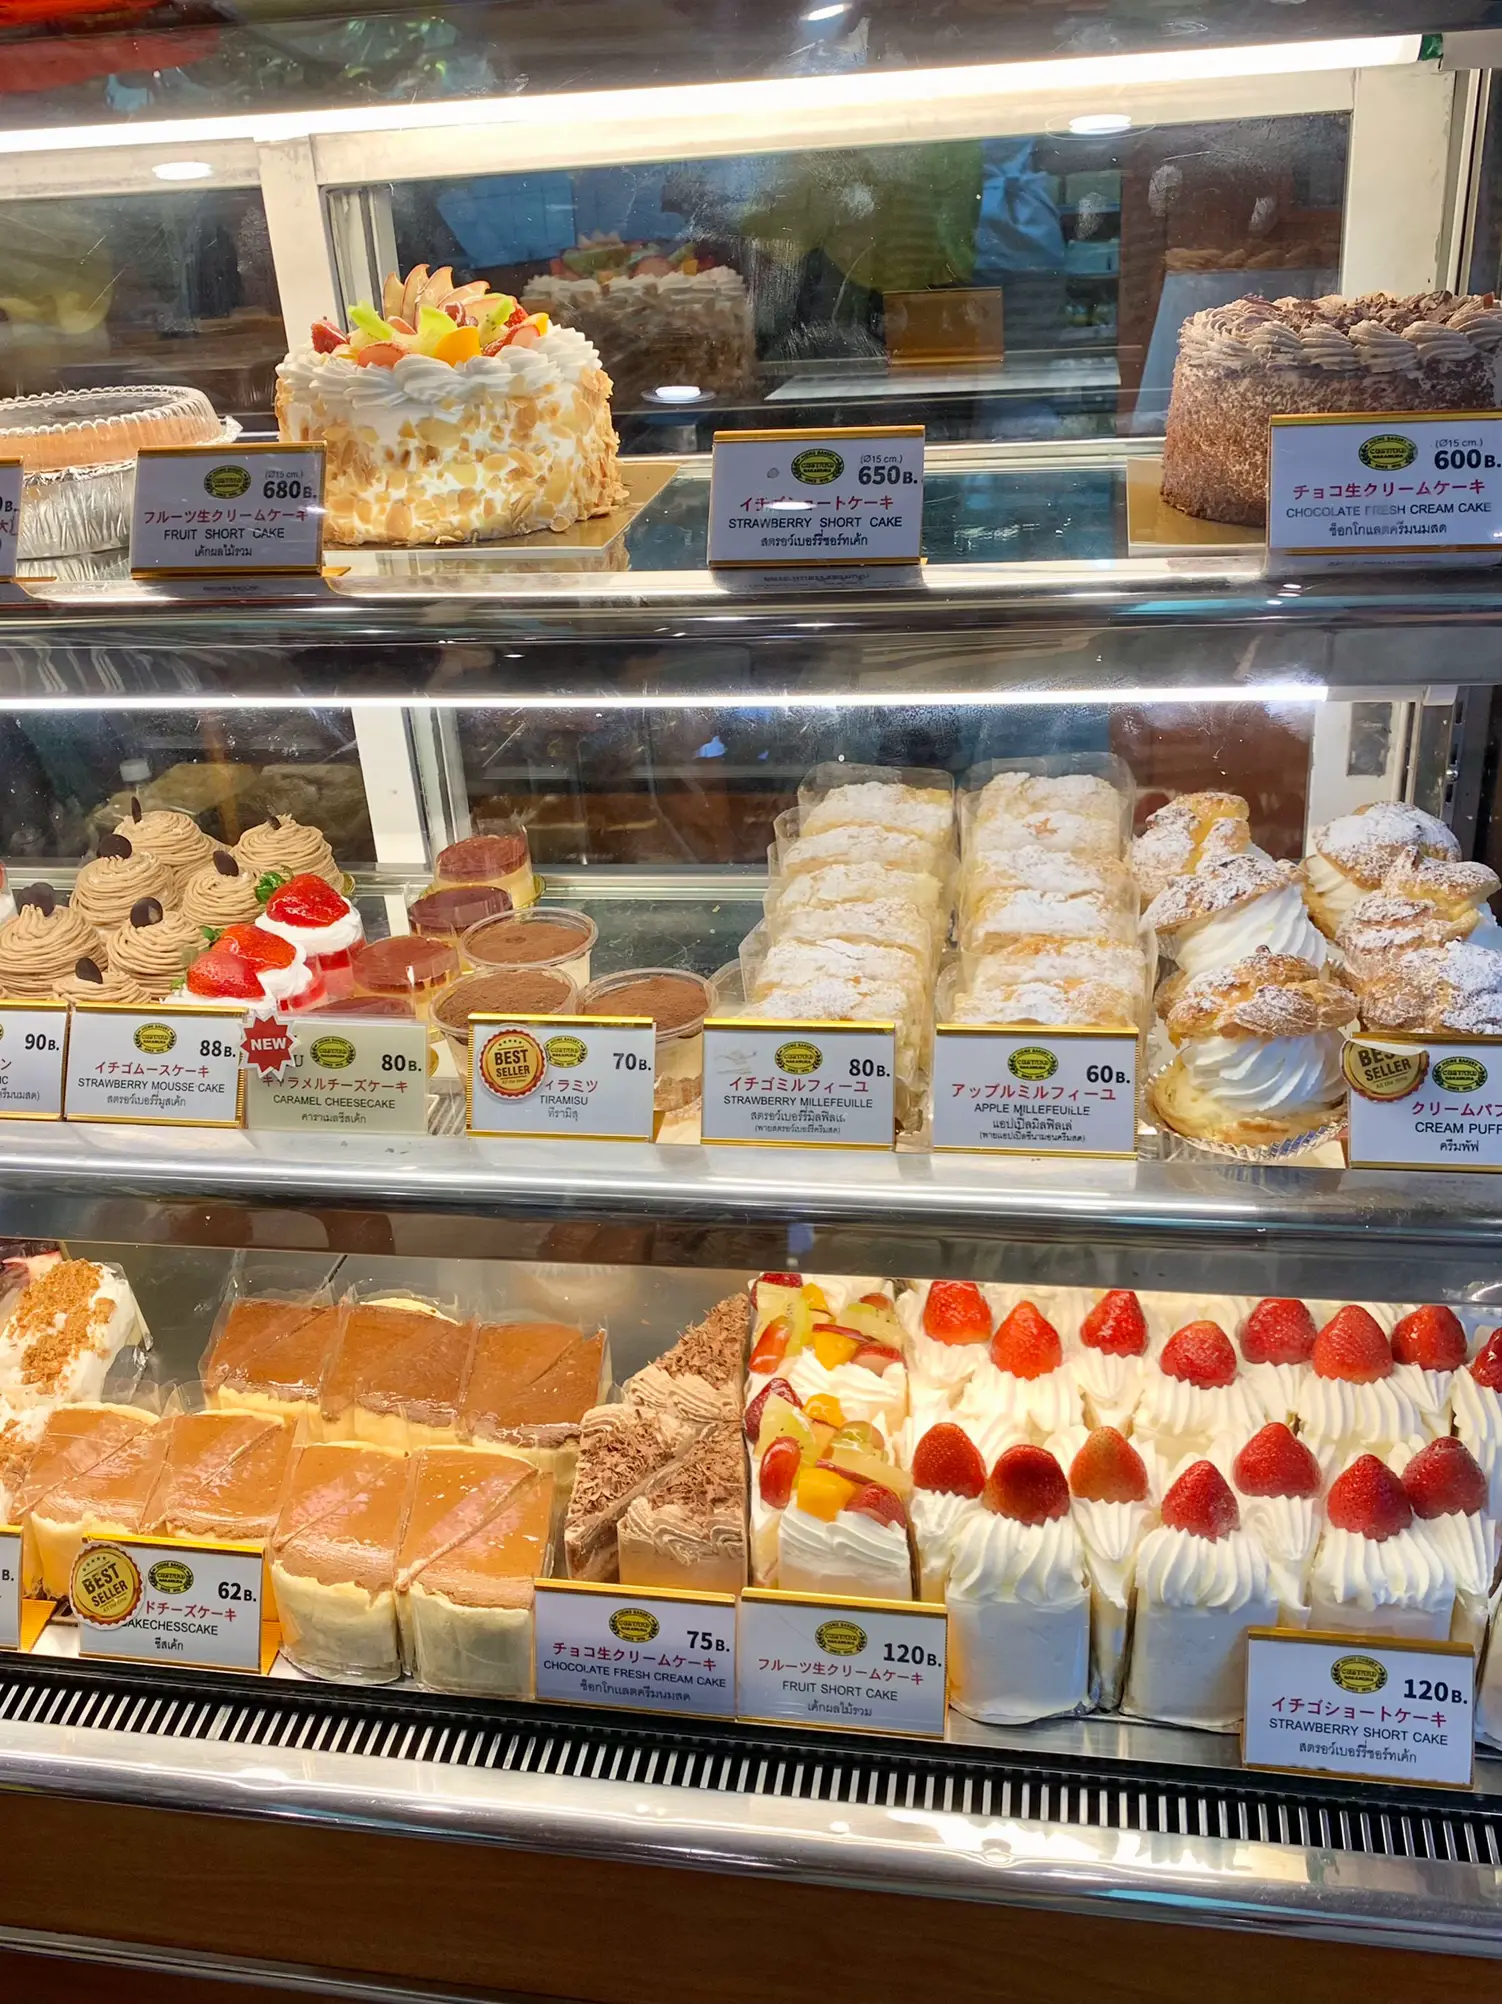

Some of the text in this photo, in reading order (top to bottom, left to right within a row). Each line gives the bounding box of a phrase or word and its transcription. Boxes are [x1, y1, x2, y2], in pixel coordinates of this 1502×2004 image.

[1435, 439, 1460, 449] (Ø15
[860, 454, 882, 464] (Ø15
[1434, 448, 1501, 470] 600B.
[858, 465, 918, 486] 650B.
[262, 480, 317, 499] 680B.
[1293, 479, 1486, 500] チョコ生クリームケーキ
[144, 508, 309, 525] フルーツ生クリームケーキ
[1286, 506, 1361, 518] CHOCOLATE
[1410, 503, 1455, 515] CREAM
[1457, 502, 1492, 513] CAKE
[728, 516, 903, 529] STRAWBERRY SHORT CAKE
[164, 527, 285, 541] FRUIT SHORT CAKE
[24, 1033, 60, 1051] 90B.
[200, 1040, 236, 1058] 88B.
[250, 1037, 287, 1051] NEW
[381, 1054, 422, 1072] 80B.
[494, 1049, 528, 1066] BEST
[612, 1053, 652, 1071] 70B.
[94, 1060, 210, 1078] イチゴムースケーキ
[496, 1065, 530, 1078] SELLER
[849, 1059, 890, 1077] 80B.
[1086, 1064, 1131, 1084] 60B.
[1364, 1058, 1412, 1082] SELLER
[78, 1077, 225, 1093] STRAWBERRY MOUSSE CAKE
[729, 1076, 869, 1094] イチゴミルフィーユ
[951, 1083, 1116, 1101] アップルミルフィーユ
[273, 1094, 396, 1109] CARAMEL CHEESECAKE
[539, 1095, 589, 1106] TIRAMISU
[723, 1095, 873, 1108] STRAWBERRY MILLEFEUILLE
[974, 1103, 1010, 1114] APPLE
[1415, 1121, 1464, 1134] CREAM
[81, 1562, 121, 1596] BEST
[91, 1579, 129, 1609] SELLER
[217, 1581, 257, 1602] 62B.
[121, 1618, 218, 1636] AKECHESSCAKE
[686, 1630, 730, 1653] 75B.
[553, 1641, 717, 1672] チョコ生クリームケーキ
[883, 1642, 942, 1668] 120B.
[543, 1660, 726, 1688] CHOCOLATE FRESH CREAM CAKE
[758, 1657, 925, 1686] フルーツ生クリームケーキ
[782, 1680, 899, 1701] FRUIT SHORT CAKE
[1403, 1678, 1468, 1705] 120B.
[1271, 1696, 1447, 1729] イチゴショートケーキ
[1269, 1717, 1449, 1746] STRAWBERRY SHORT CAKE
